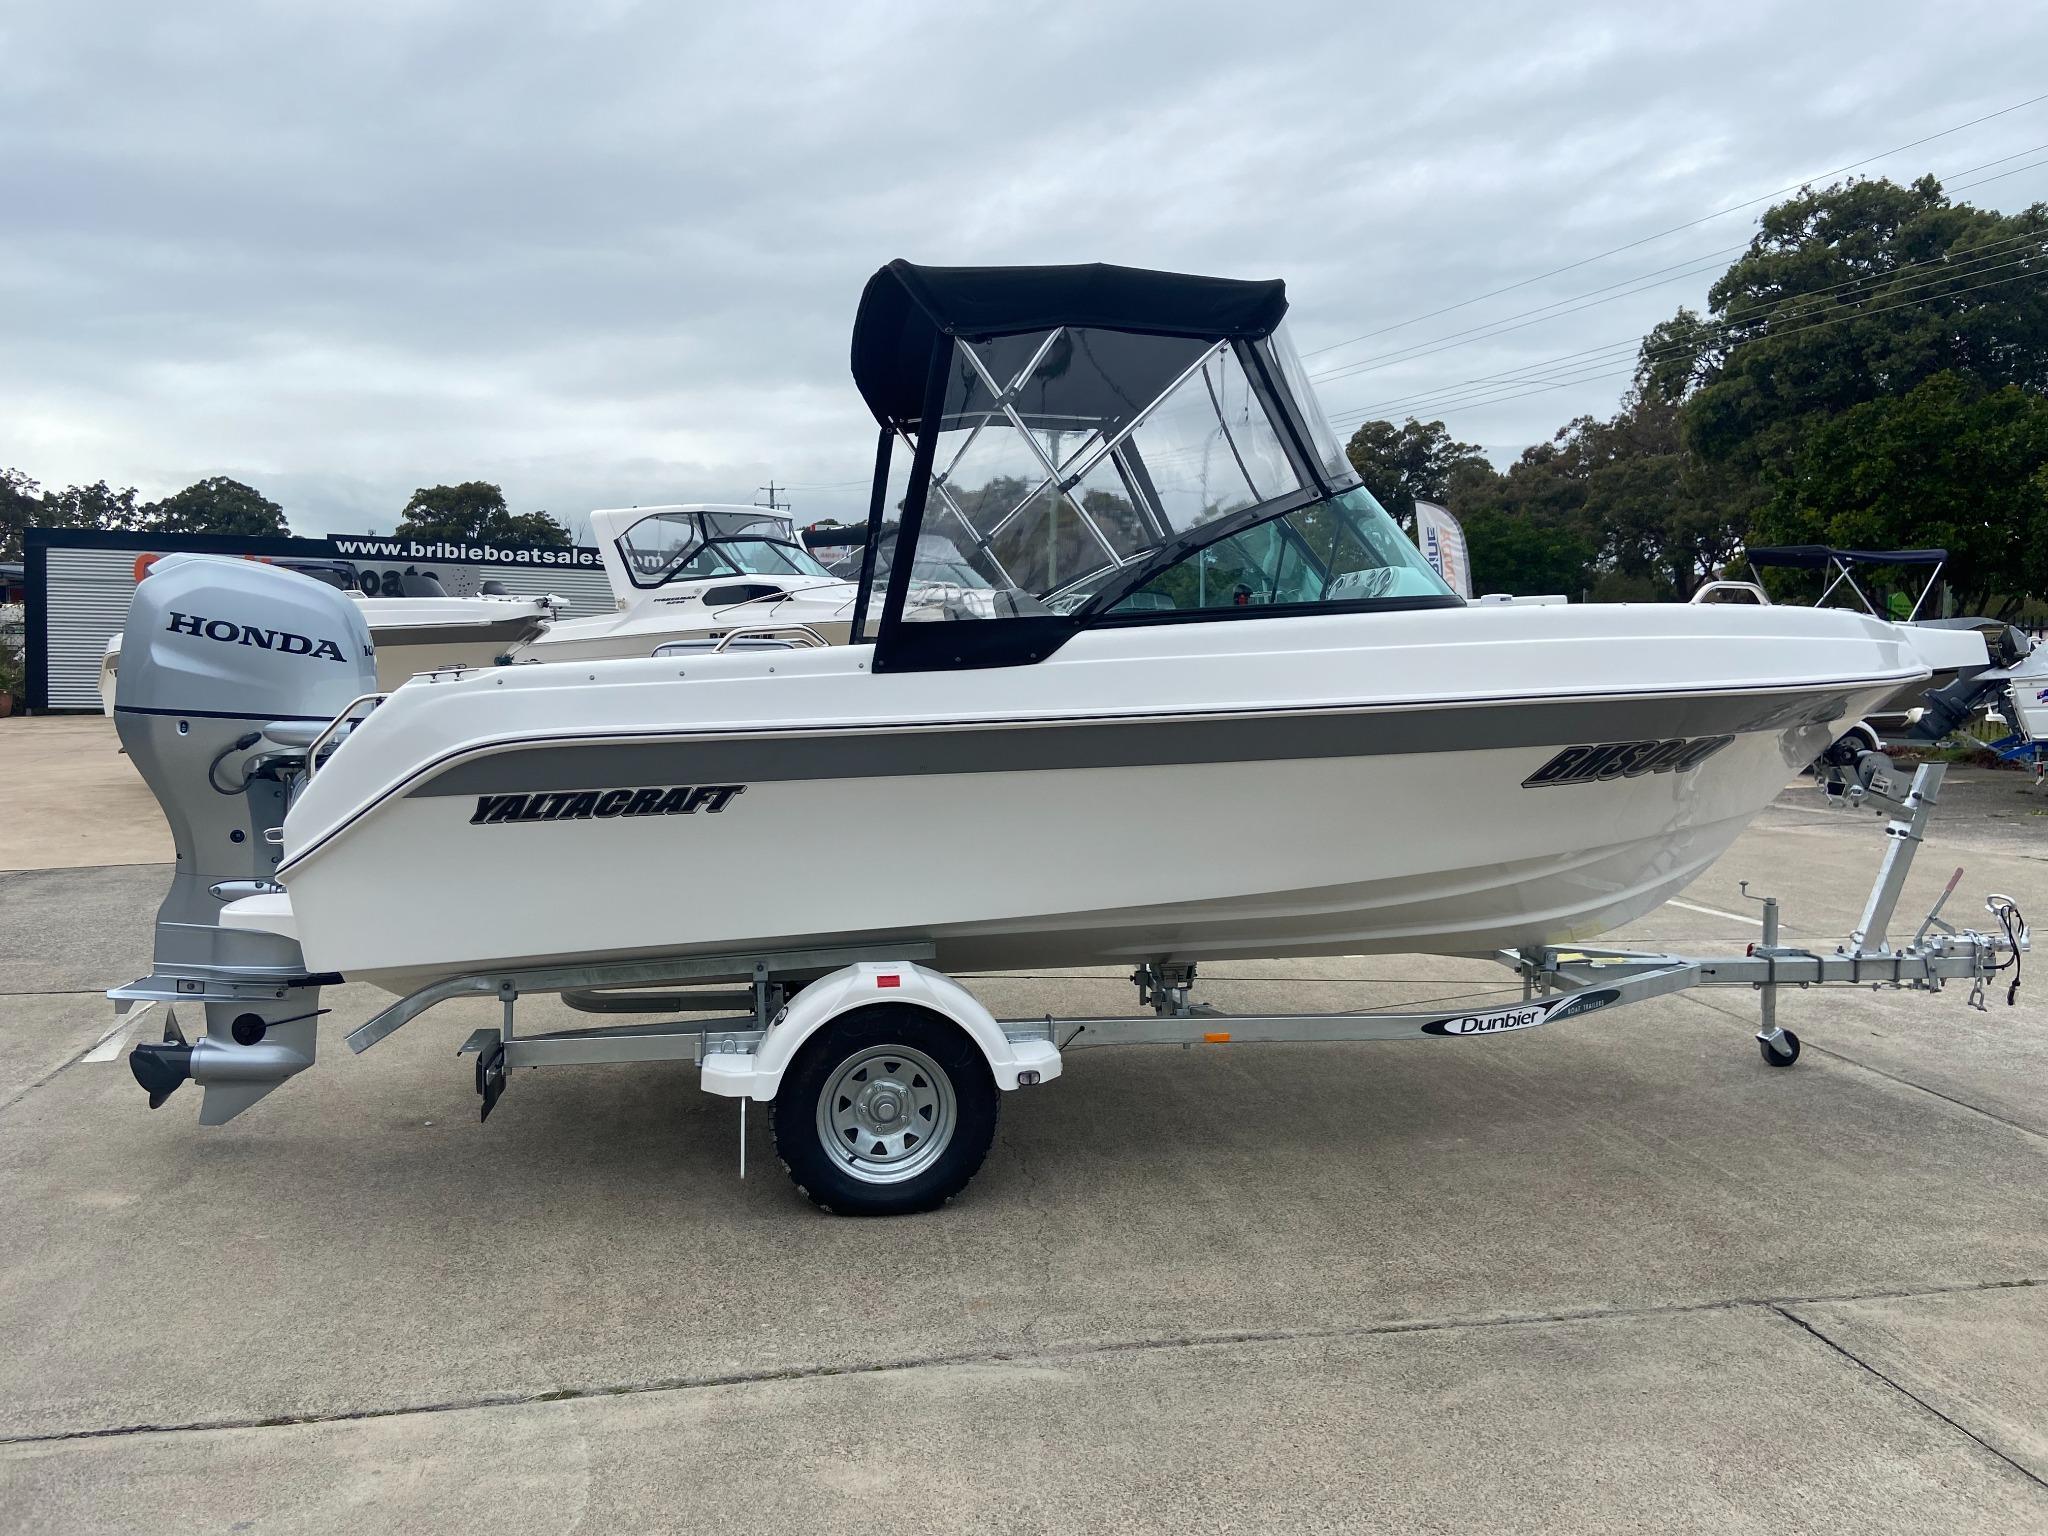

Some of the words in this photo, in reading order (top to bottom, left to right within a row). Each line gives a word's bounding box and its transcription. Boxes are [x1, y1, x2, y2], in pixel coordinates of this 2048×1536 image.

[166, 611, 347, 663] HONDA
[469, 784, 749, 826] YALTACRAFT
[1459, 1011, 1539, 1034] Dunbier
